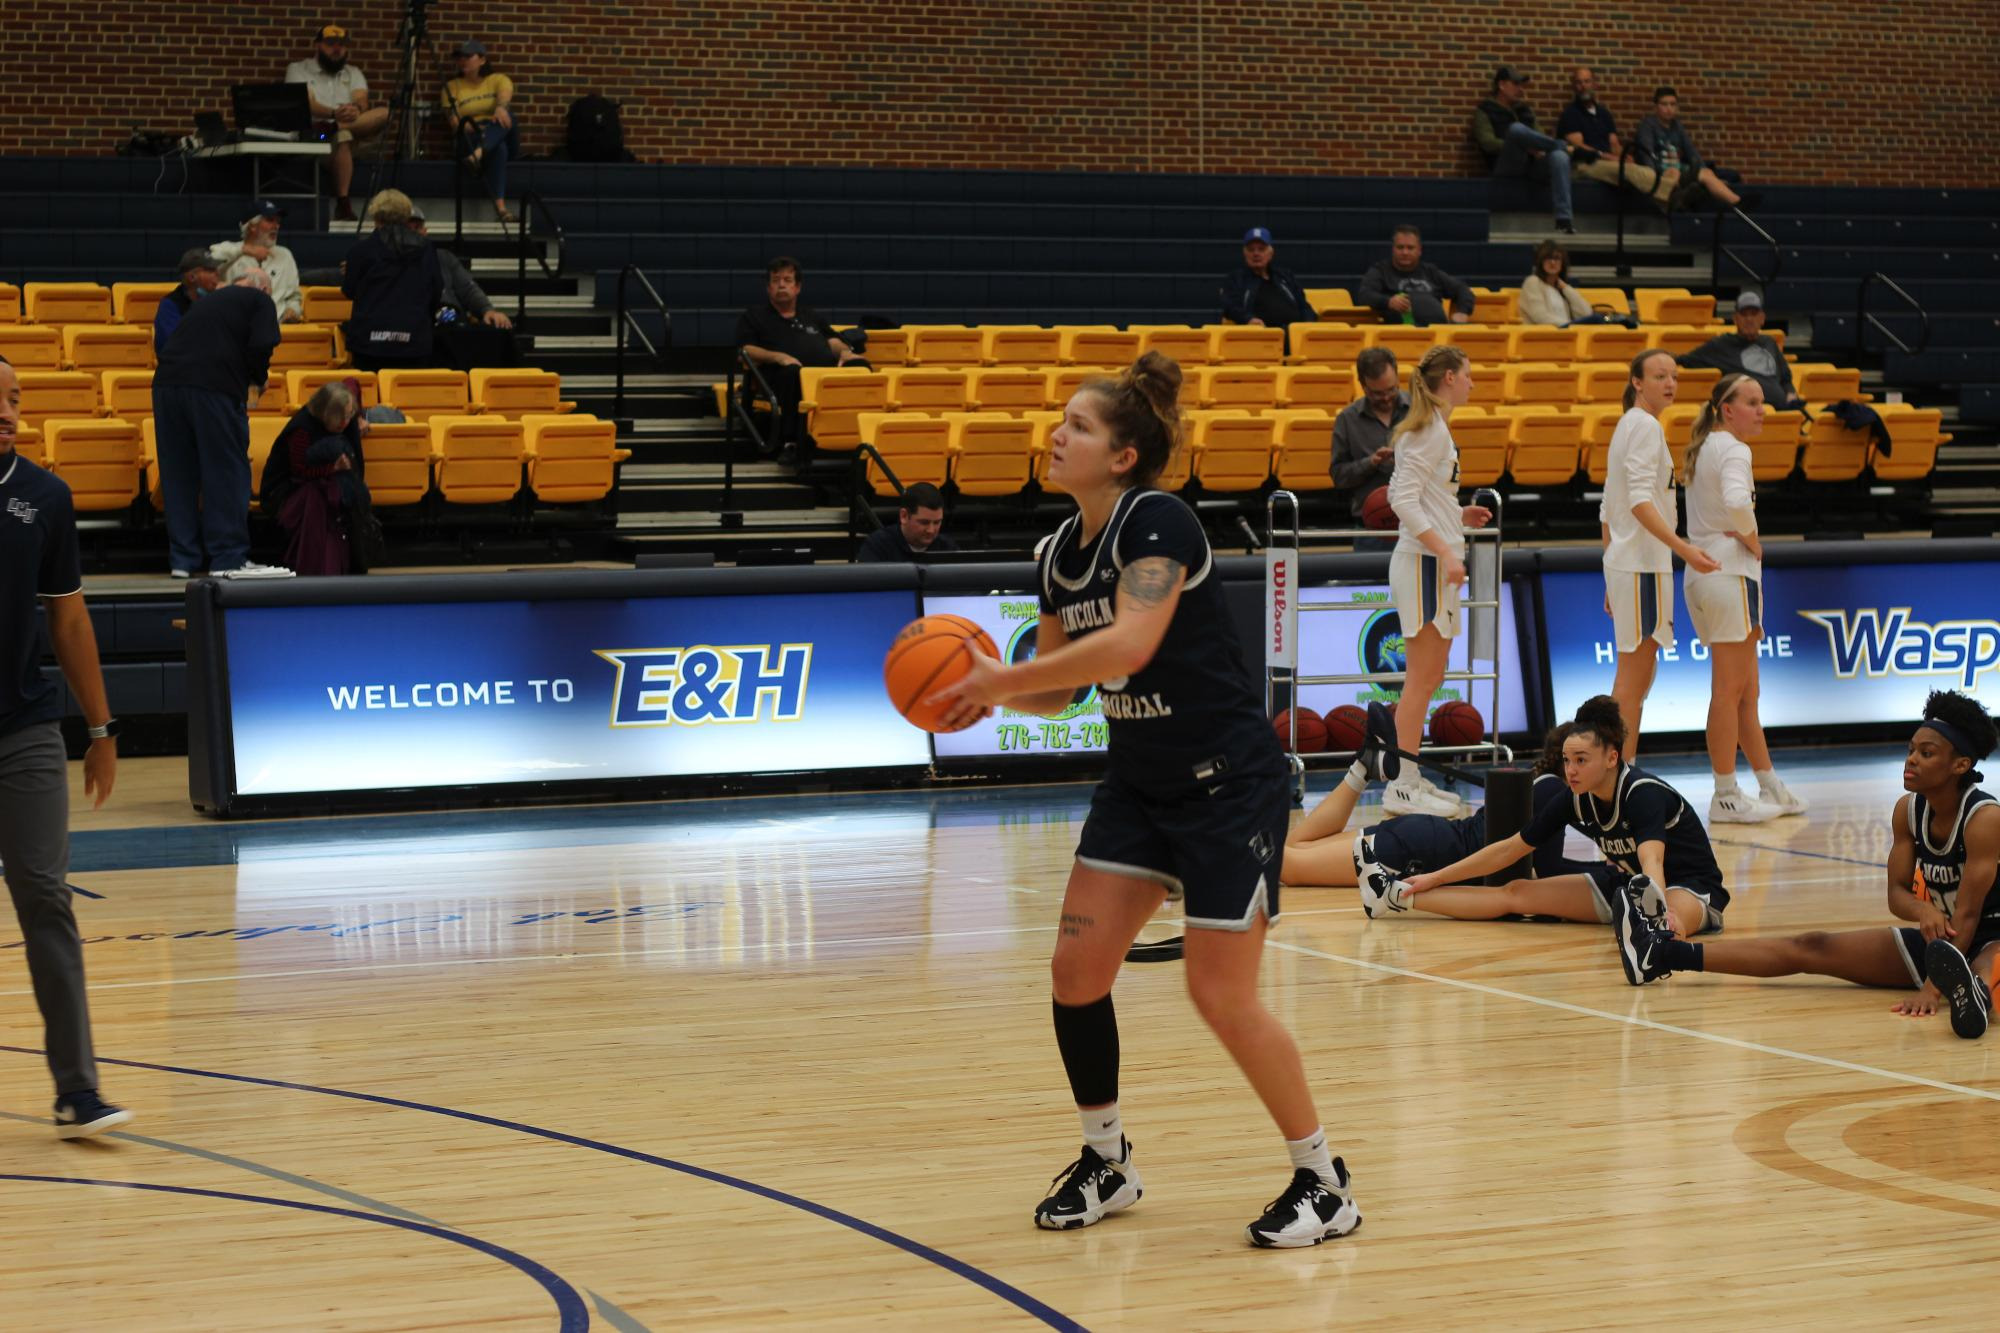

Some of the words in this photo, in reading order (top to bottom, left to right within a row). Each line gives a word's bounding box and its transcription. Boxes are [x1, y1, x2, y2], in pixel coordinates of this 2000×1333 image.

[1271, 559, 1286, 653] Wilson
[1594, 638, 1680, 664] HE
[1756, 634, 1794, 658] HE
[1797, 606, 2000, 692] Wasp
[326, 680, 515, 711] WELCOME
[527, 678, 574, 704] TO
[591, 642, 813, 729] E&H
[996, 721, 1110, 750] 276-782-260
